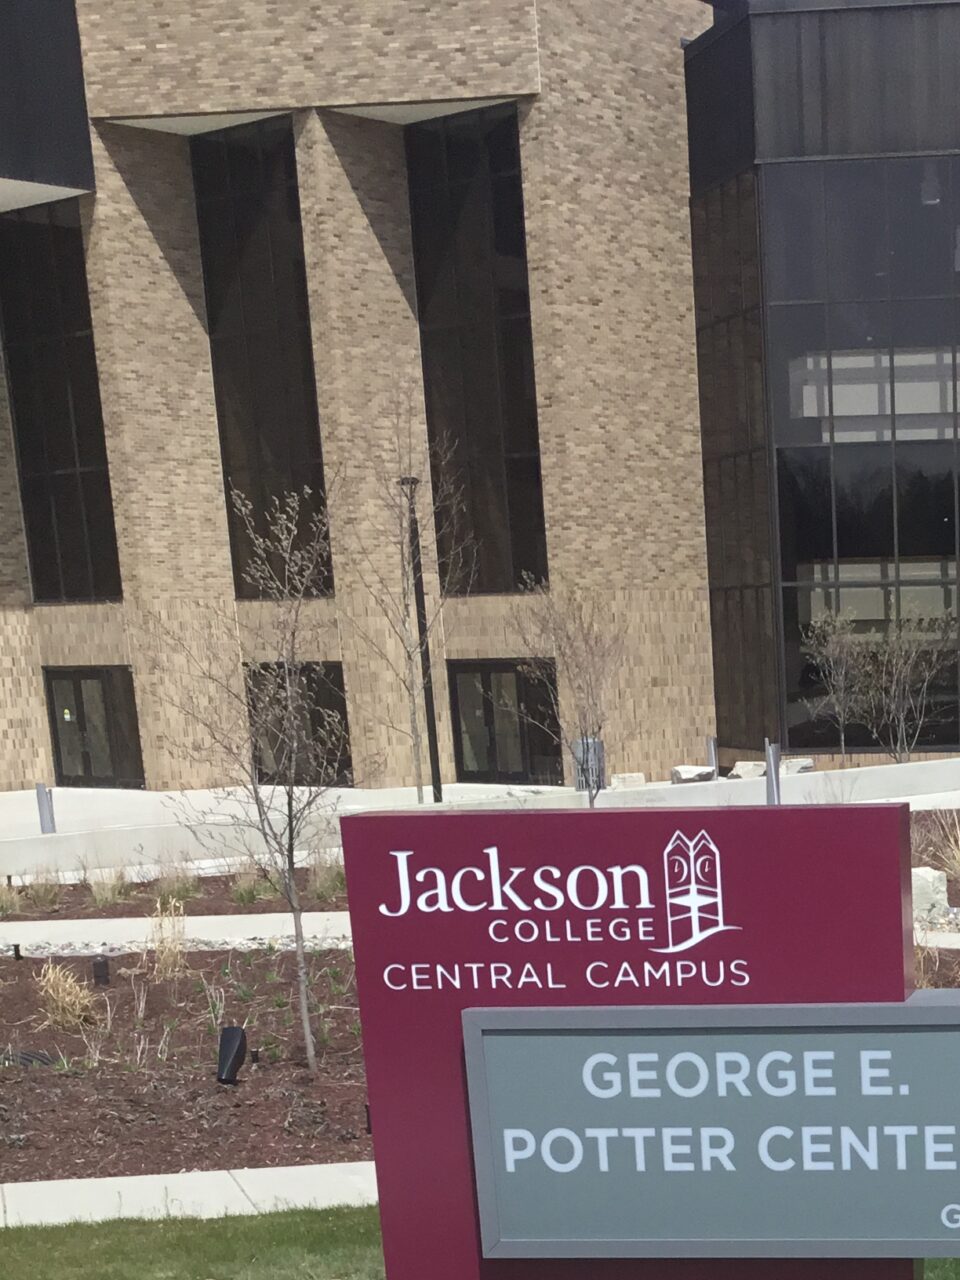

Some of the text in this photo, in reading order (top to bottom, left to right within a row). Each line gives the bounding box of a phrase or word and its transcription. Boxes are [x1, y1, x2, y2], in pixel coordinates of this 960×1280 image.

[377, 846, 656, 917] Jackson
[488, 918, 656, 943] COLLEGE
[382, 959, 751, 990] CENTRAL CAMPUS
[582, 1050, 911, 1099] GEORGE E.
[503, 1127, 737, 1173] POTTER
